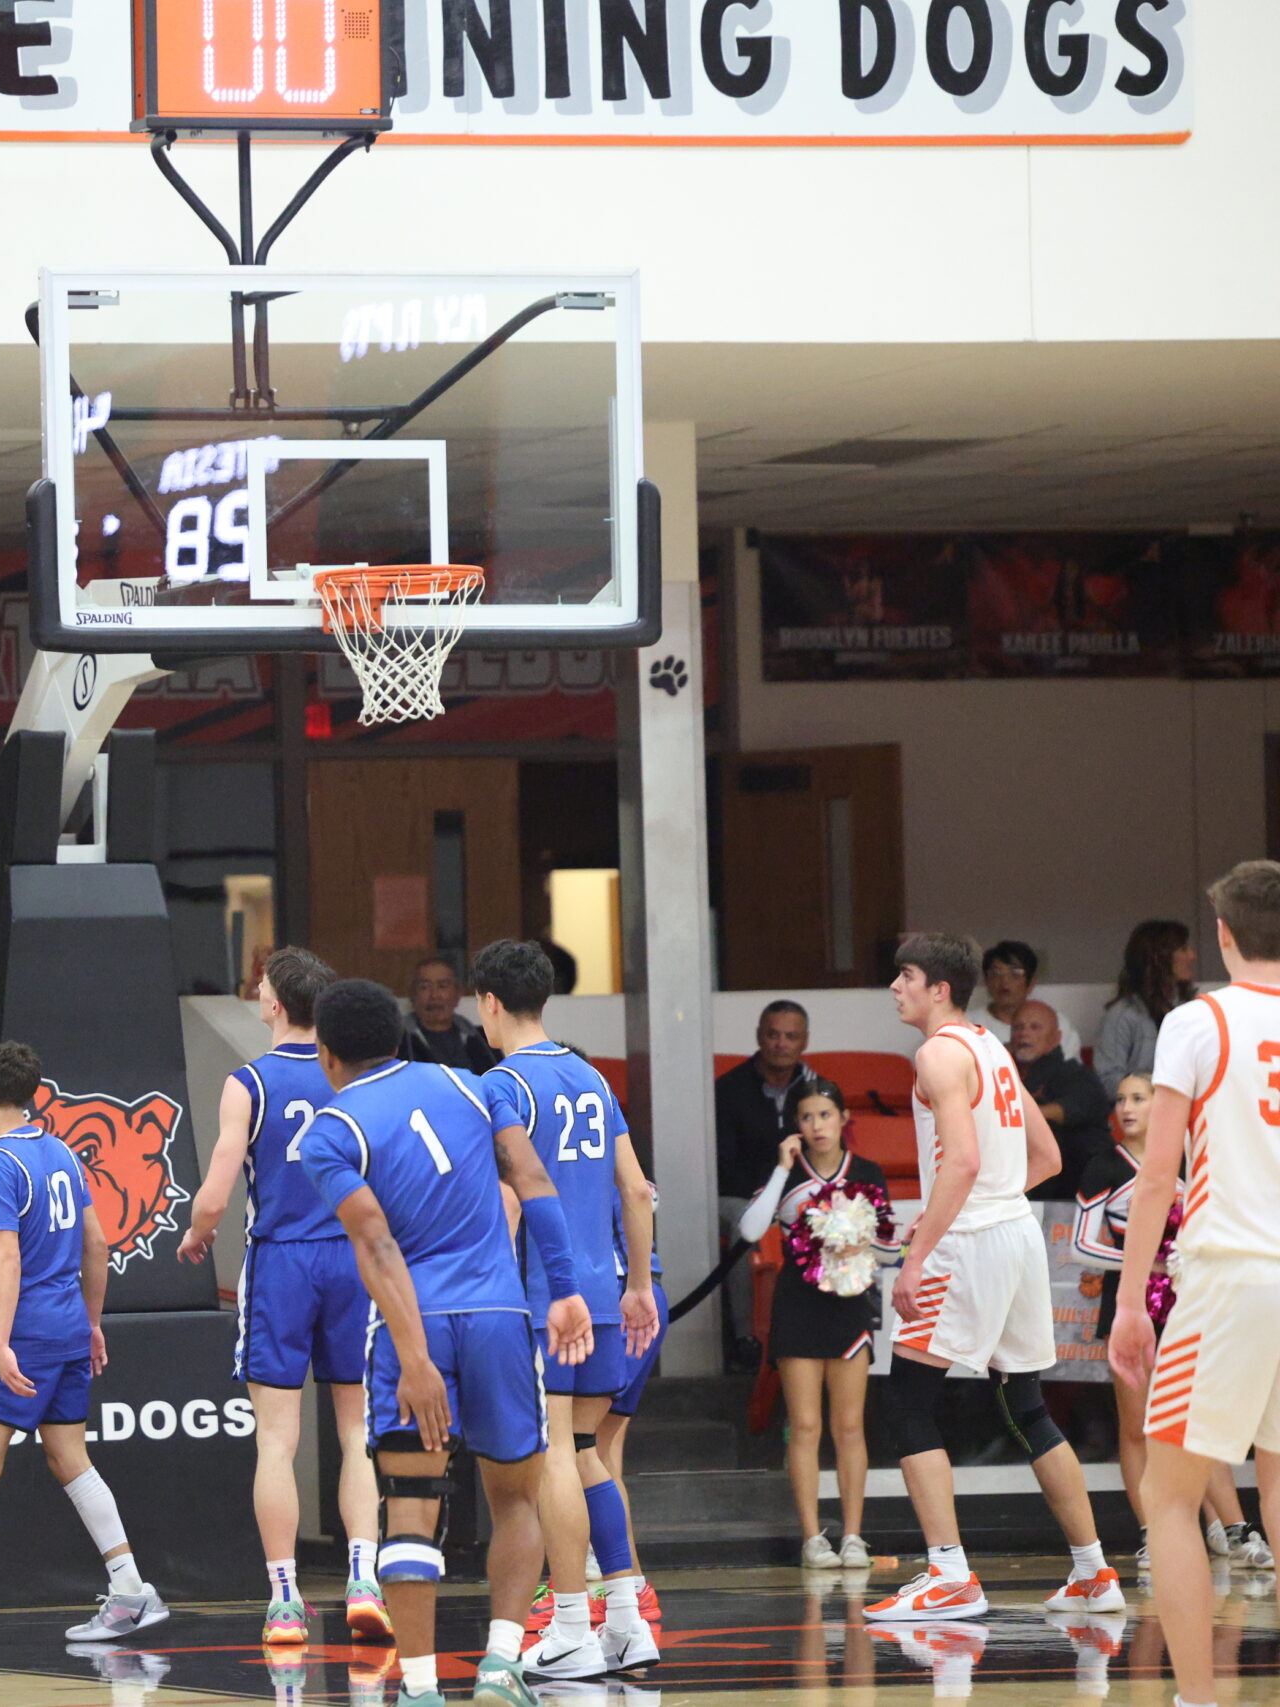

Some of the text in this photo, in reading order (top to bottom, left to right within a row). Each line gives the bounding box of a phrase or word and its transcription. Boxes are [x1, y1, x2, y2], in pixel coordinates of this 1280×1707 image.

[839, 0, 1169, 101] DOGS
[76, 611, 134, 626] SPALDING
[554, 1091, 606, 1163] 23
[991, 1066, 1024, 1129] 42
[409, 1107, 454, 1176] 1
[46, 1169, 77, 1233] 10
